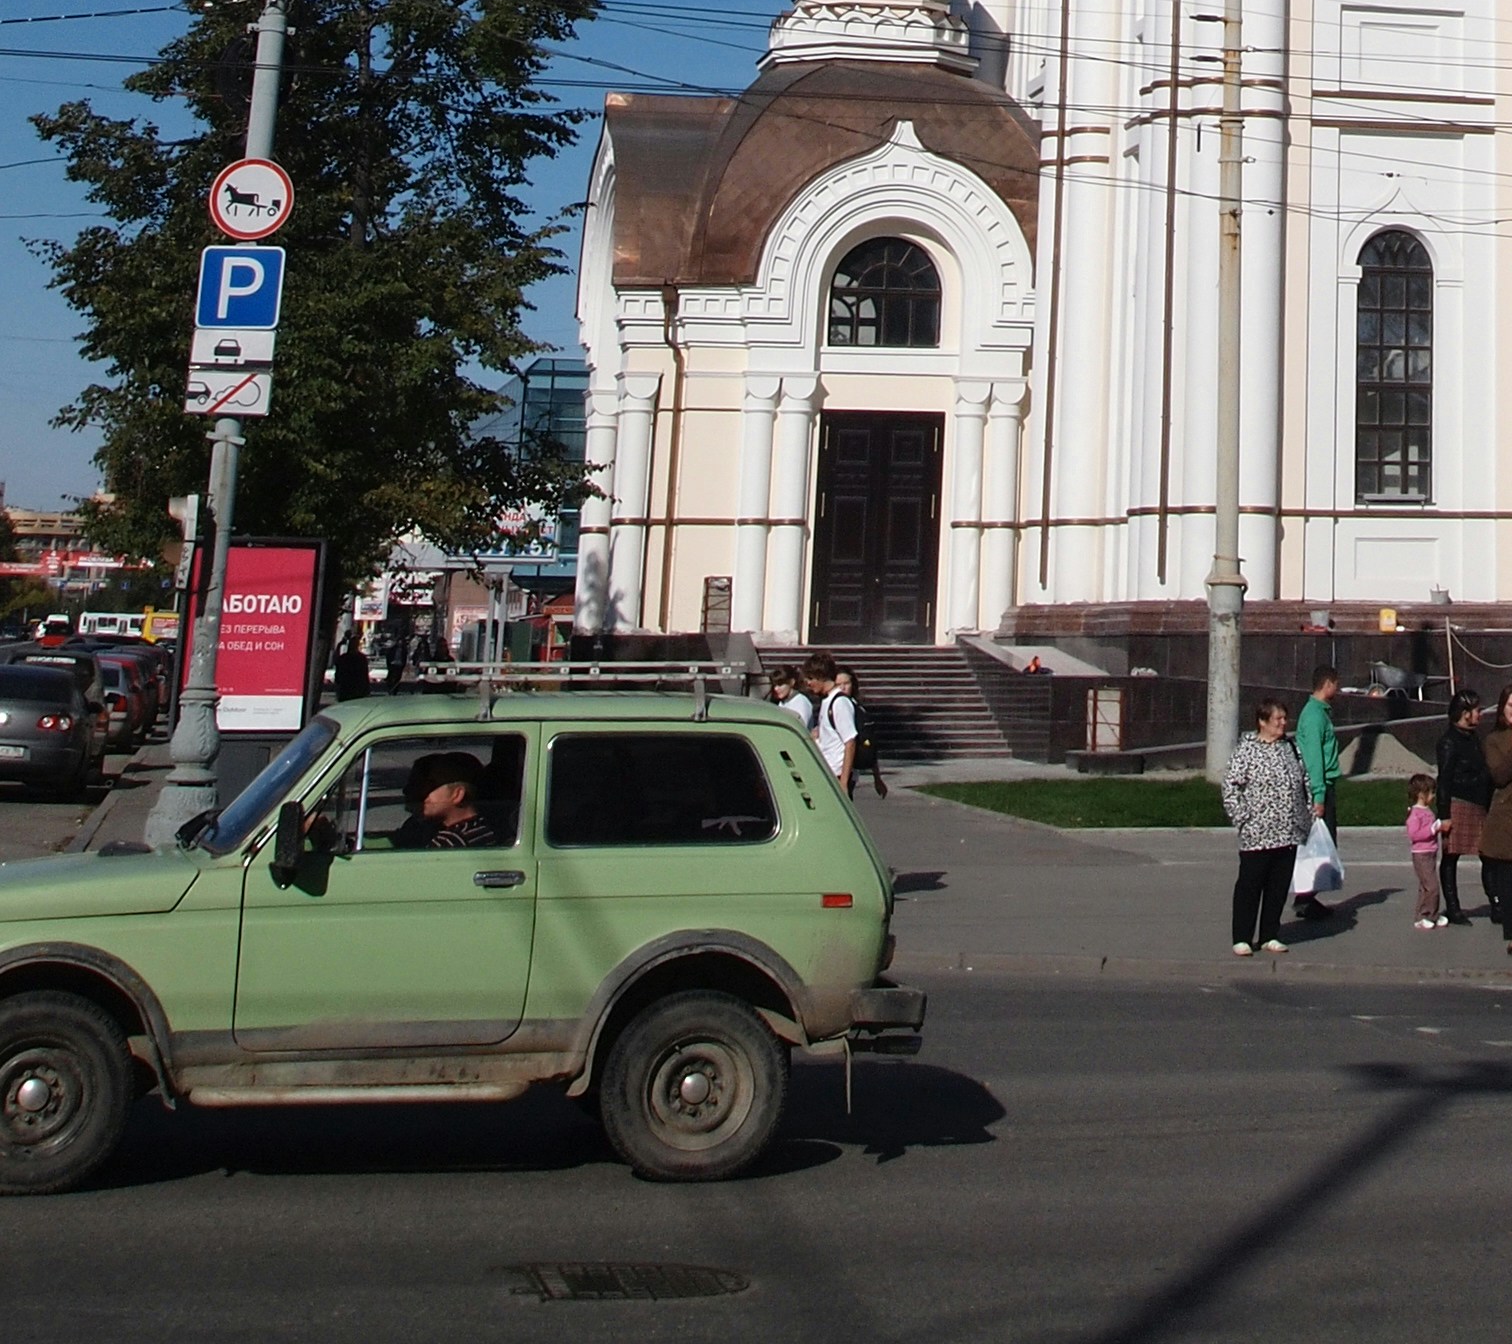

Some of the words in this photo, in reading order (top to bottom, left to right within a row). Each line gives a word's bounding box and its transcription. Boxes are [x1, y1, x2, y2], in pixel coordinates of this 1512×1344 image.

[217, 256, 265, 319] P
[220, 624, 232, 634] ЕЗ
[233, 624, 286, 634] ПЕРЕРЫВА
[227, 641, 253, 652] ОБЕД
[255, 641, 263, 651] И
[264, 641, 285, 651] СОН
